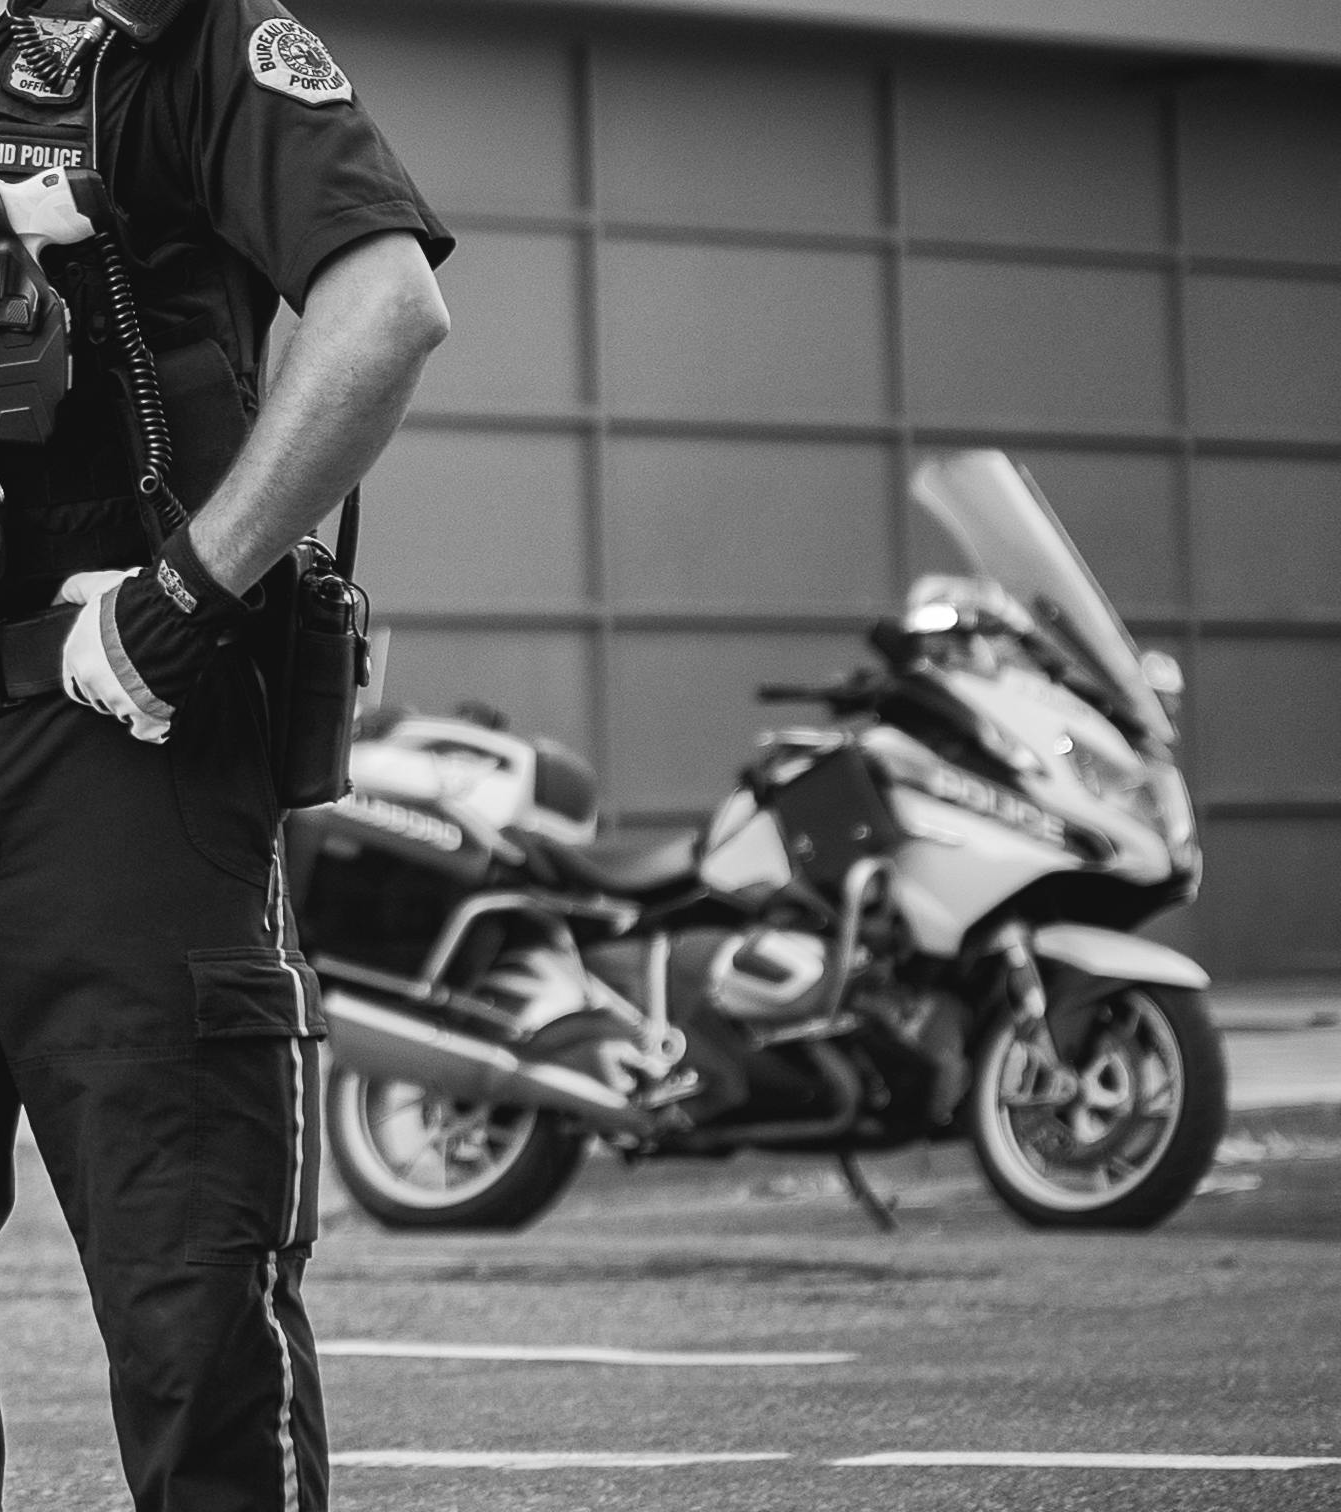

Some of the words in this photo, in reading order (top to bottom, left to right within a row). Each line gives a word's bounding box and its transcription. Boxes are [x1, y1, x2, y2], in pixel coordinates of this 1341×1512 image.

[257, 23, 283, 73] BUREAU
[20, 79, 52, 93] OFFIC
[20, 145, 83, 168] POLICE
